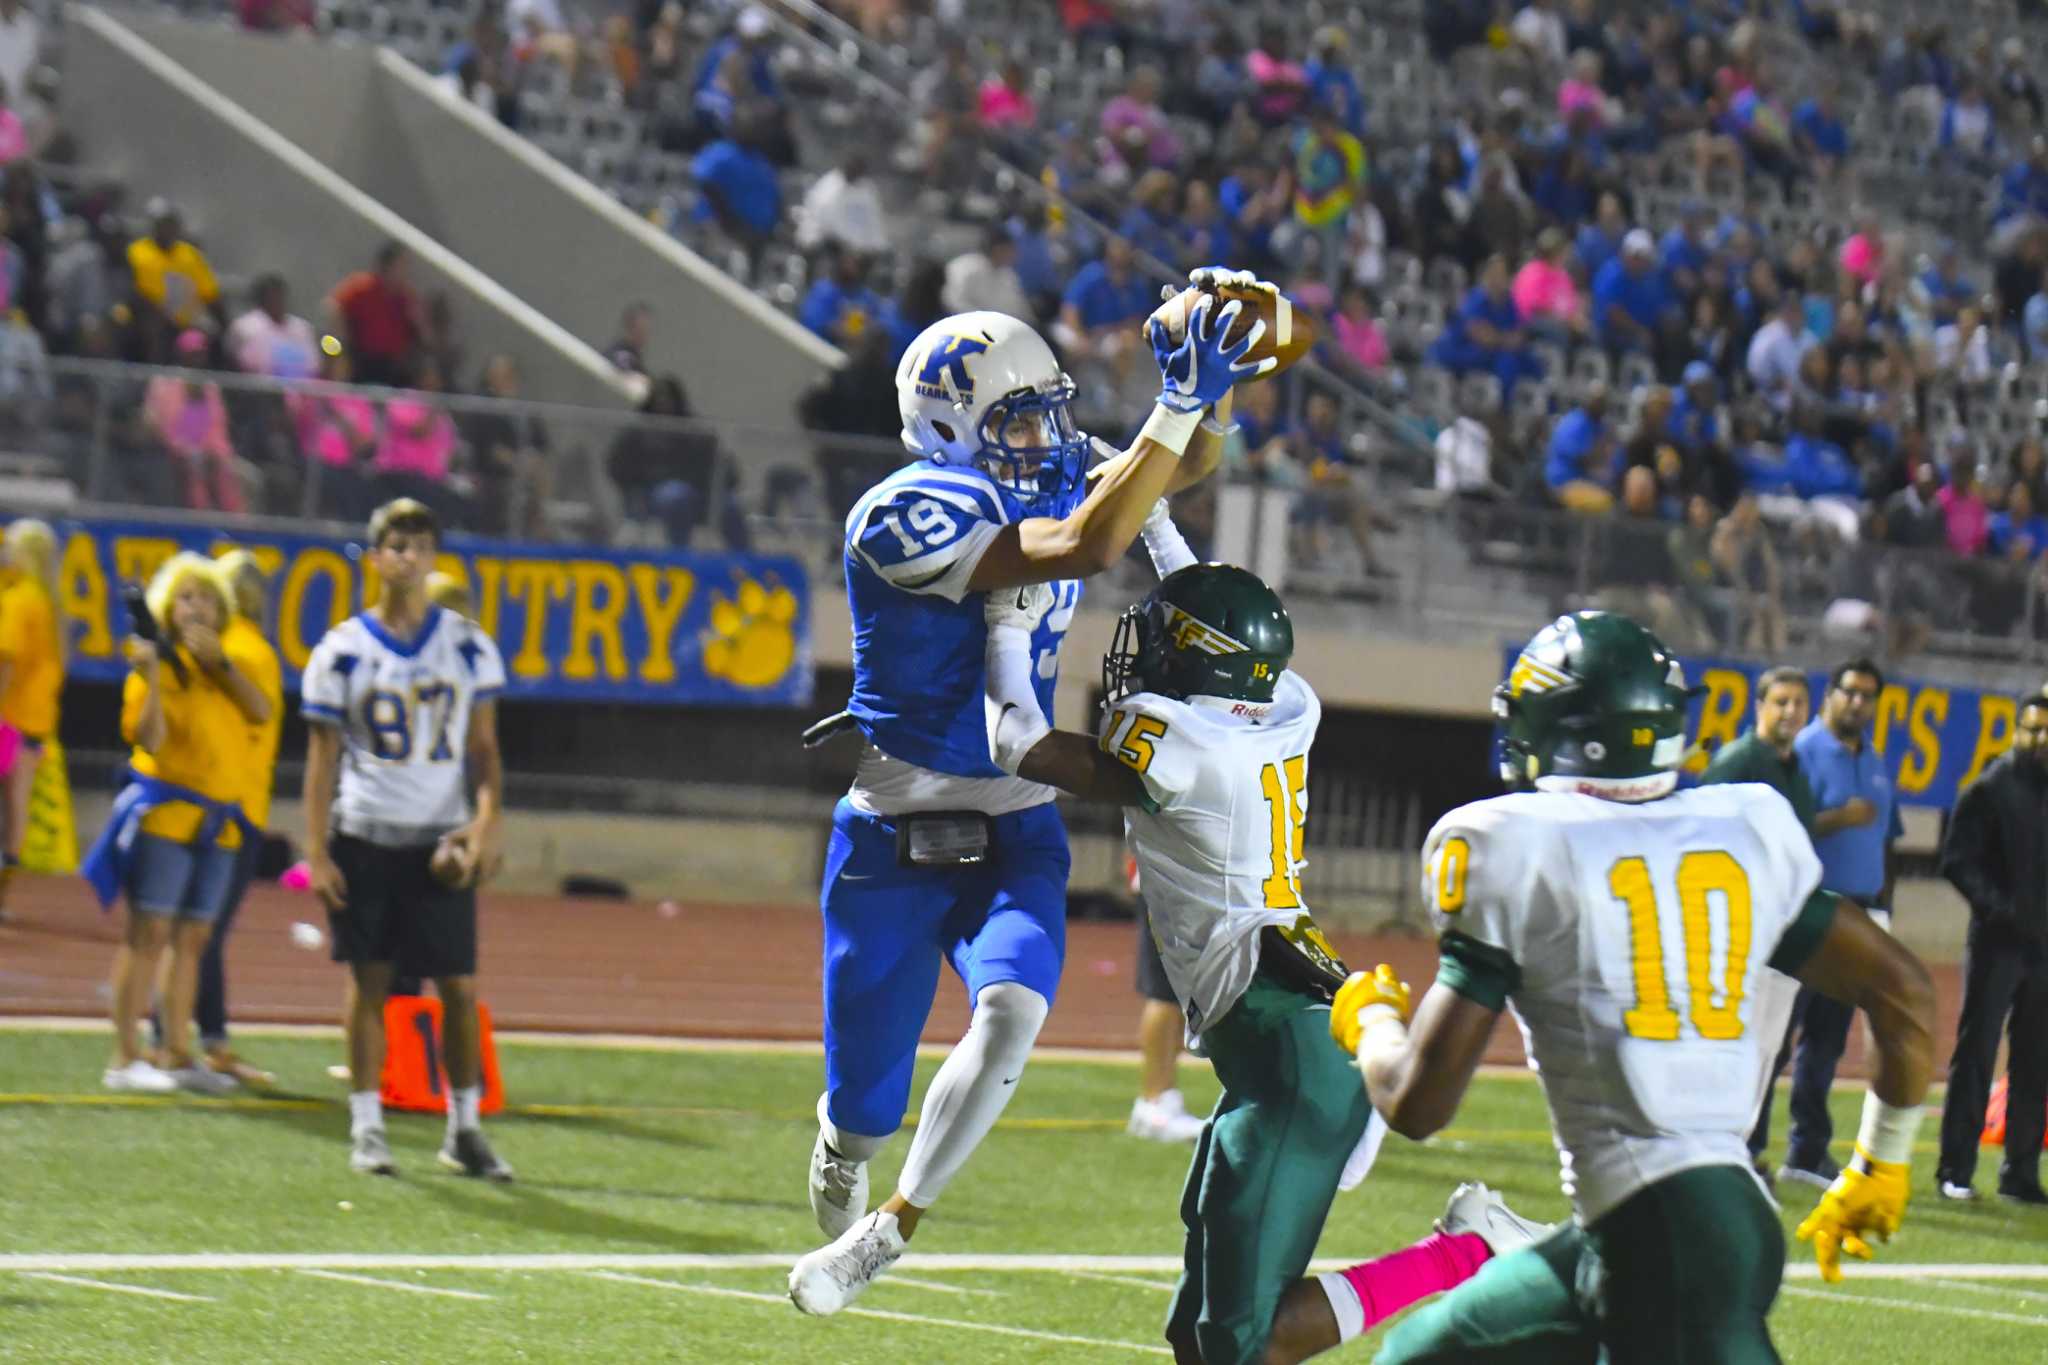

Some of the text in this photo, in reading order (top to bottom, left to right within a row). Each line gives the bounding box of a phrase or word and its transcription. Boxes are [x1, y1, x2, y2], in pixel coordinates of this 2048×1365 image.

[916, 333, 990, 392] K
[883, 498, 957, 557] 19
[59, 531, 180, 657] AT
[1253, 663, 1269, 678] 15
[1101, 709, 1169, 774] 15
[1425, 836, 1470, 914] 0
[1606, 849, 1752, 1041] 10
